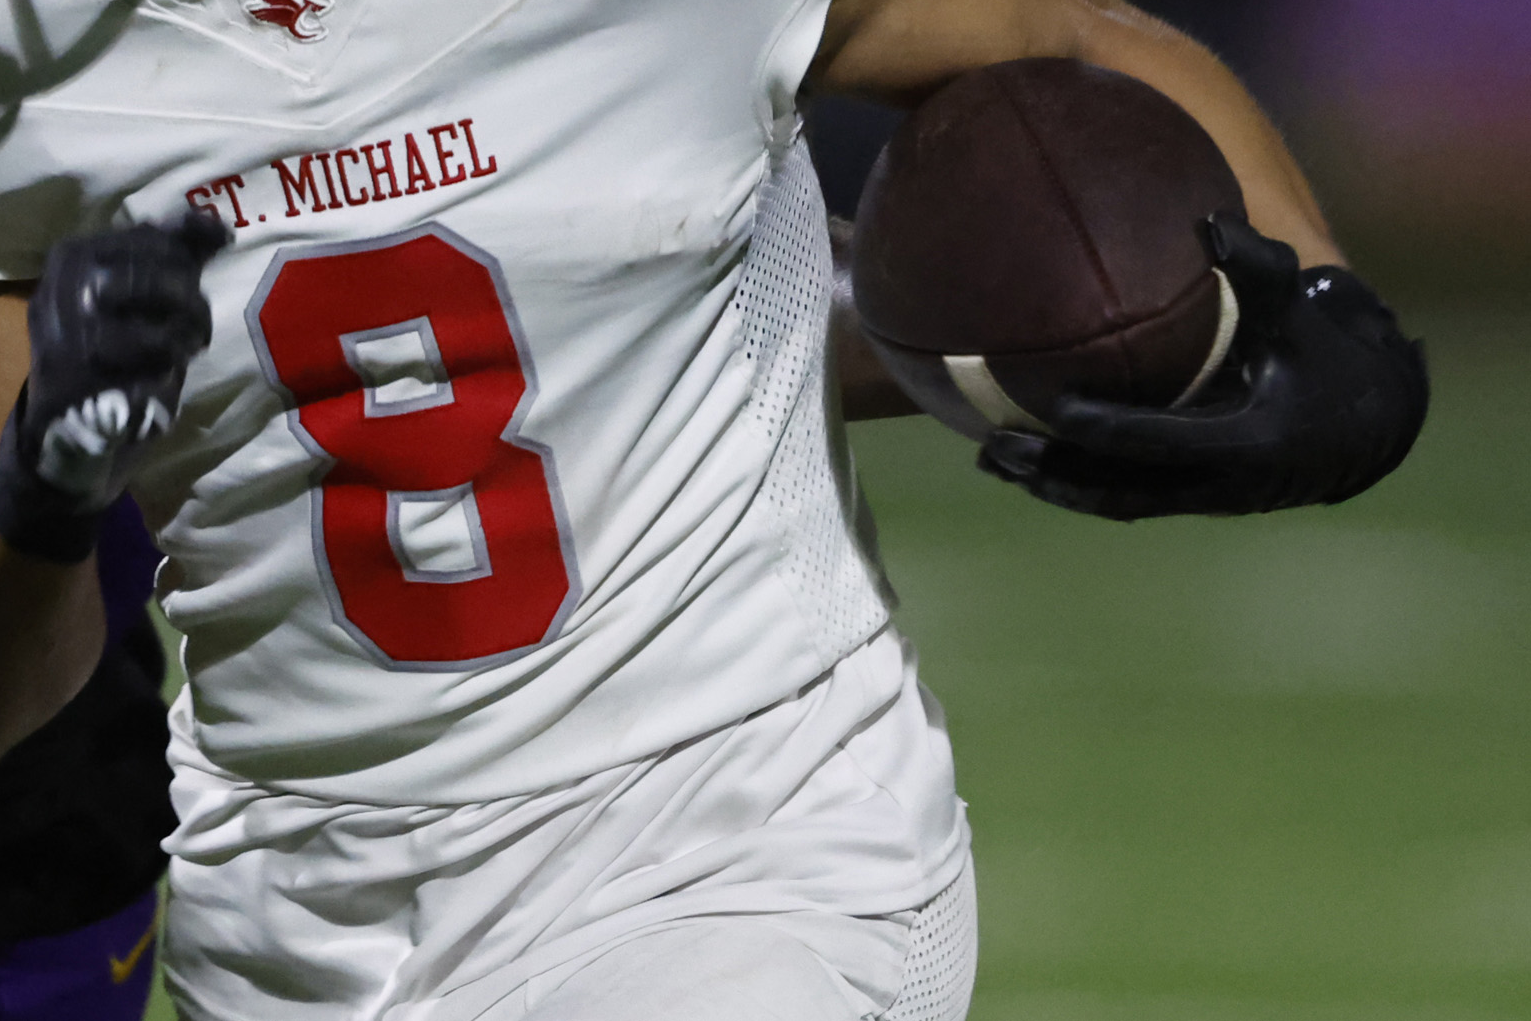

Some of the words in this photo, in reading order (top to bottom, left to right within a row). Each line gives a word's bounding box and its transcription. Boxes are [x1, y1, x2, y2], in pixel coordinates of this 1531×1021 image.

[185, 174, 267, 228] ST.
[271, 118, 498, 218] MICHAEL
[244, 220, 584, 673] 8
